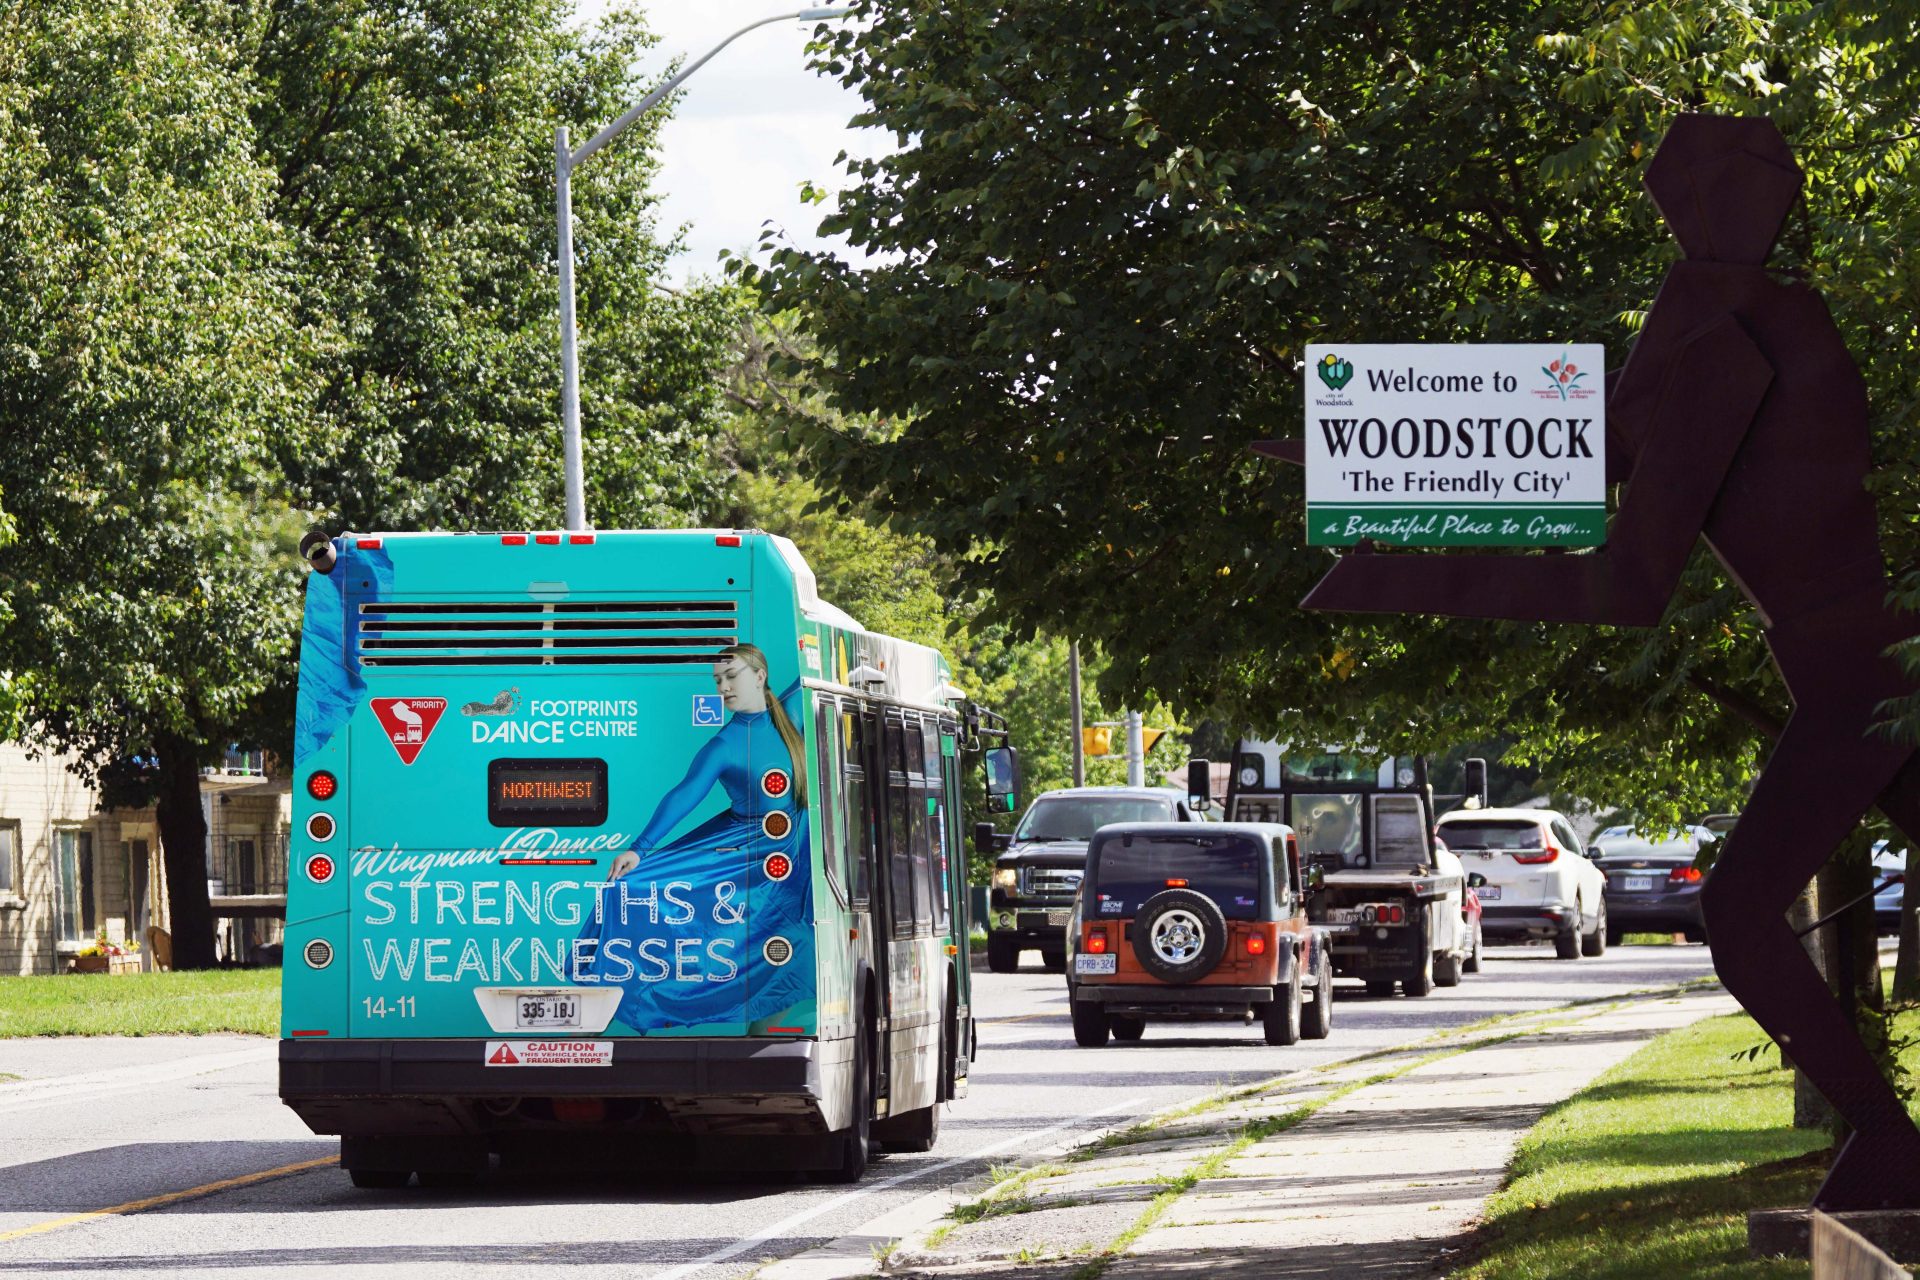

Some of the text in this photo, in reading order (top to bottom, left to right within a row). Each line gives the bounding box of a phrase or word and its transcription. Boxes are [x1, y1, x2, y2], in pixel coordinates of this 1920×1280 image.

[1367, 367, 1517, 392] Welcome to
[1319, 418, 1593, 459] WOODSTOCK
[1342, 470, 1570, 499] 'The Friendly City'
[1323, 514, 1591, 542] a Beautiful Place to Grow...
[411, 701, 444, 709] PRIORITY
[531, 700, 638, 717] FOOTPRINTS
[472, 721, 638, 743] DANCE CENTRE
[502, 782, 593, 798] NORTHWEST
[365, 880, 746, 926] STRENGTHS &
[363, 938, 738, 982] WEAKNESSES
[363, 996, 416, 1019] 14-11
[527, 1043, 595, 1051] CAUTION
